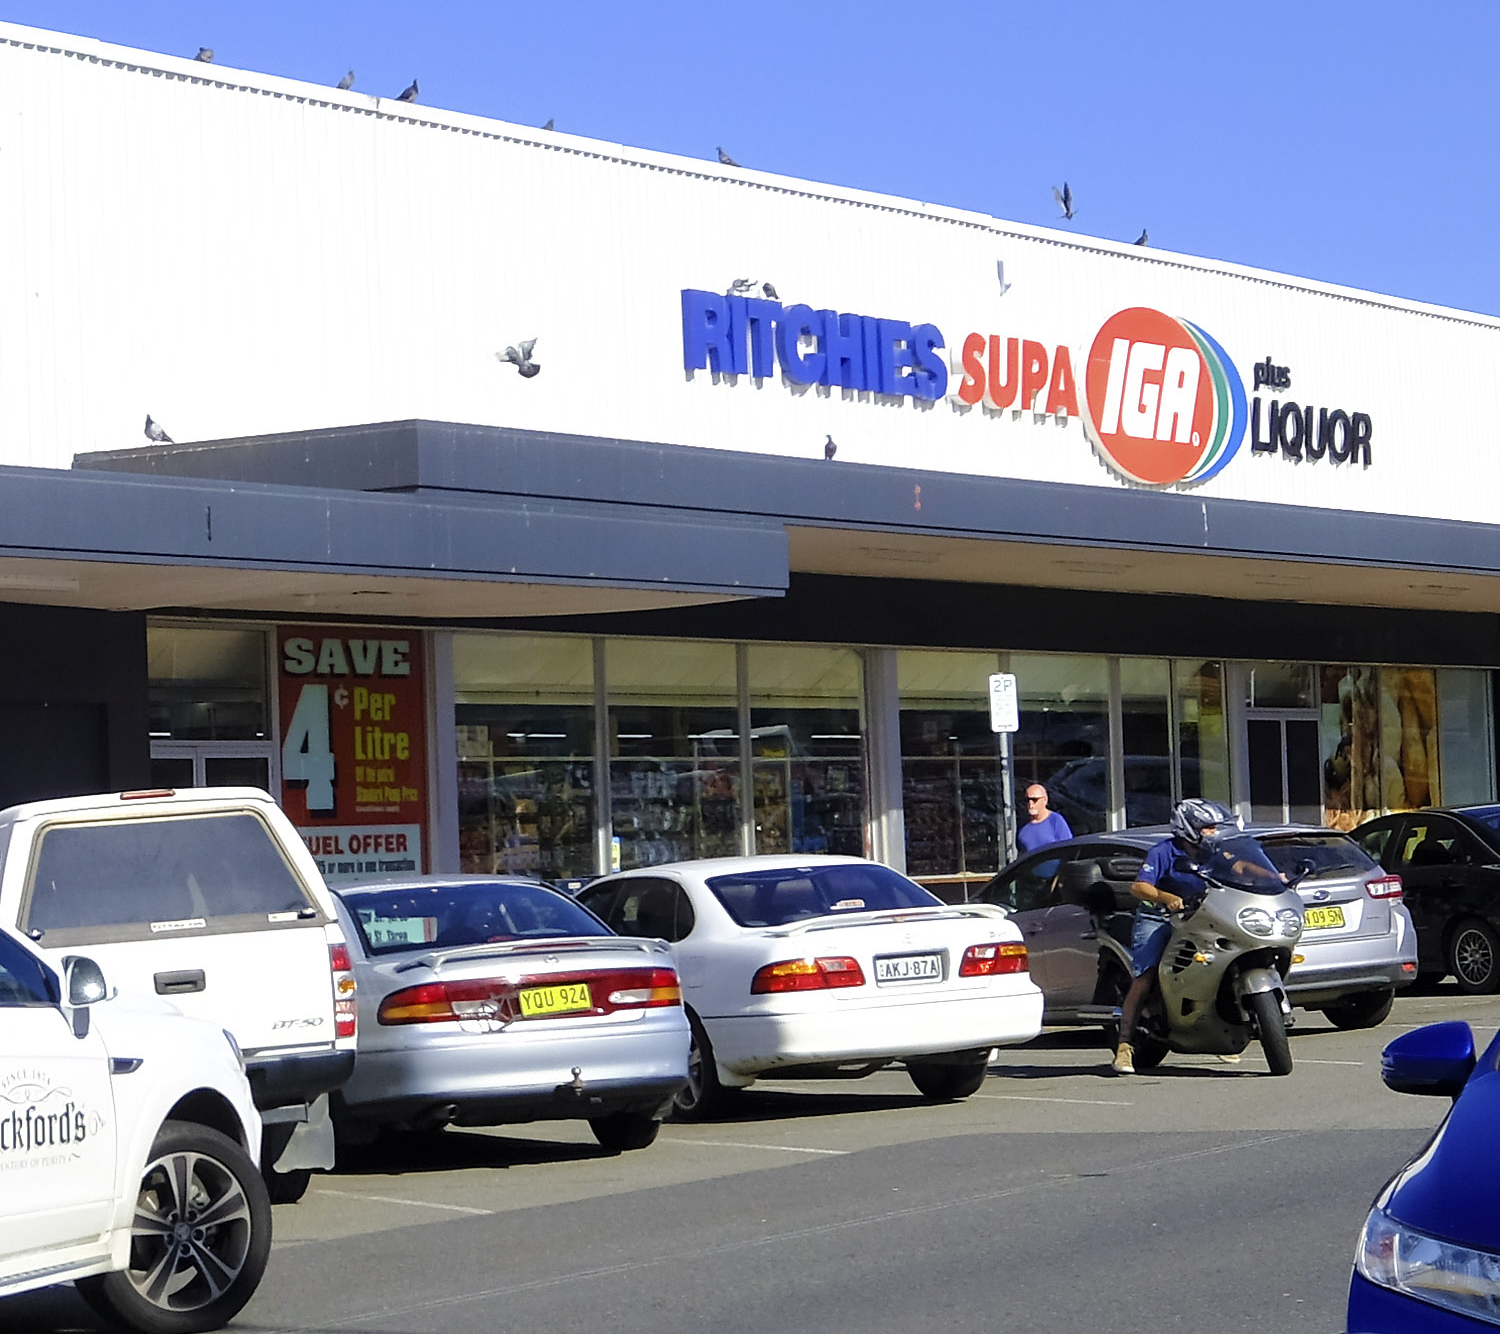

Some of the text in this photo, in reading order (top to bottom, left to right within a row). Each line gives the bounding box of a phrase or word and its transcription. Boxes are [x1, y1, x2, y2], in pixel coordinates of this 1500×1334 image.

[680, 288, 1200, 444] RITCHIES SUPA IGA
[1253, 356, 1292, 390] plus
[1249, 400, 1373, 466] LIQUOR
[284, 637, 410, 675] SAVE
[353, 686, 397, 721] Per
[993, 679, 1013, 693] 2P
[282, 683, 335, 810] 4
[354, 726, 410, 761] Litre
[304, 833, 408, 856] UEL OFFER
[522, 986, 588, 1010] YQU 924
